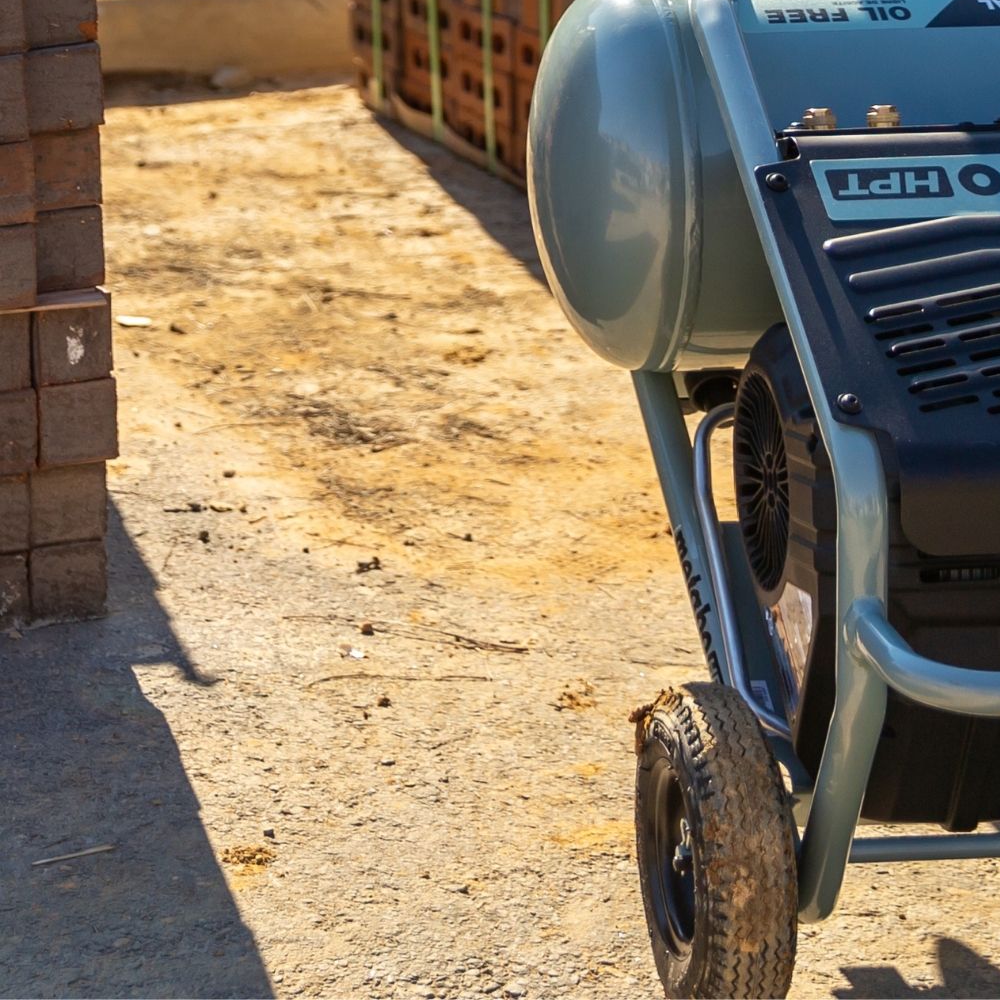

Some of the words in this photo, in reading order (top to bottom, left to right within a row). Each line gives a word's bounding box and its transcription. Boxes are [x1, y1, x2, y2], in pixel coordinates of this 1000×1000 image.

[763, 7, 850, 25] FREE
[857, 6, 912, 22] OIL
[837, 171, 941, 196] HPT
